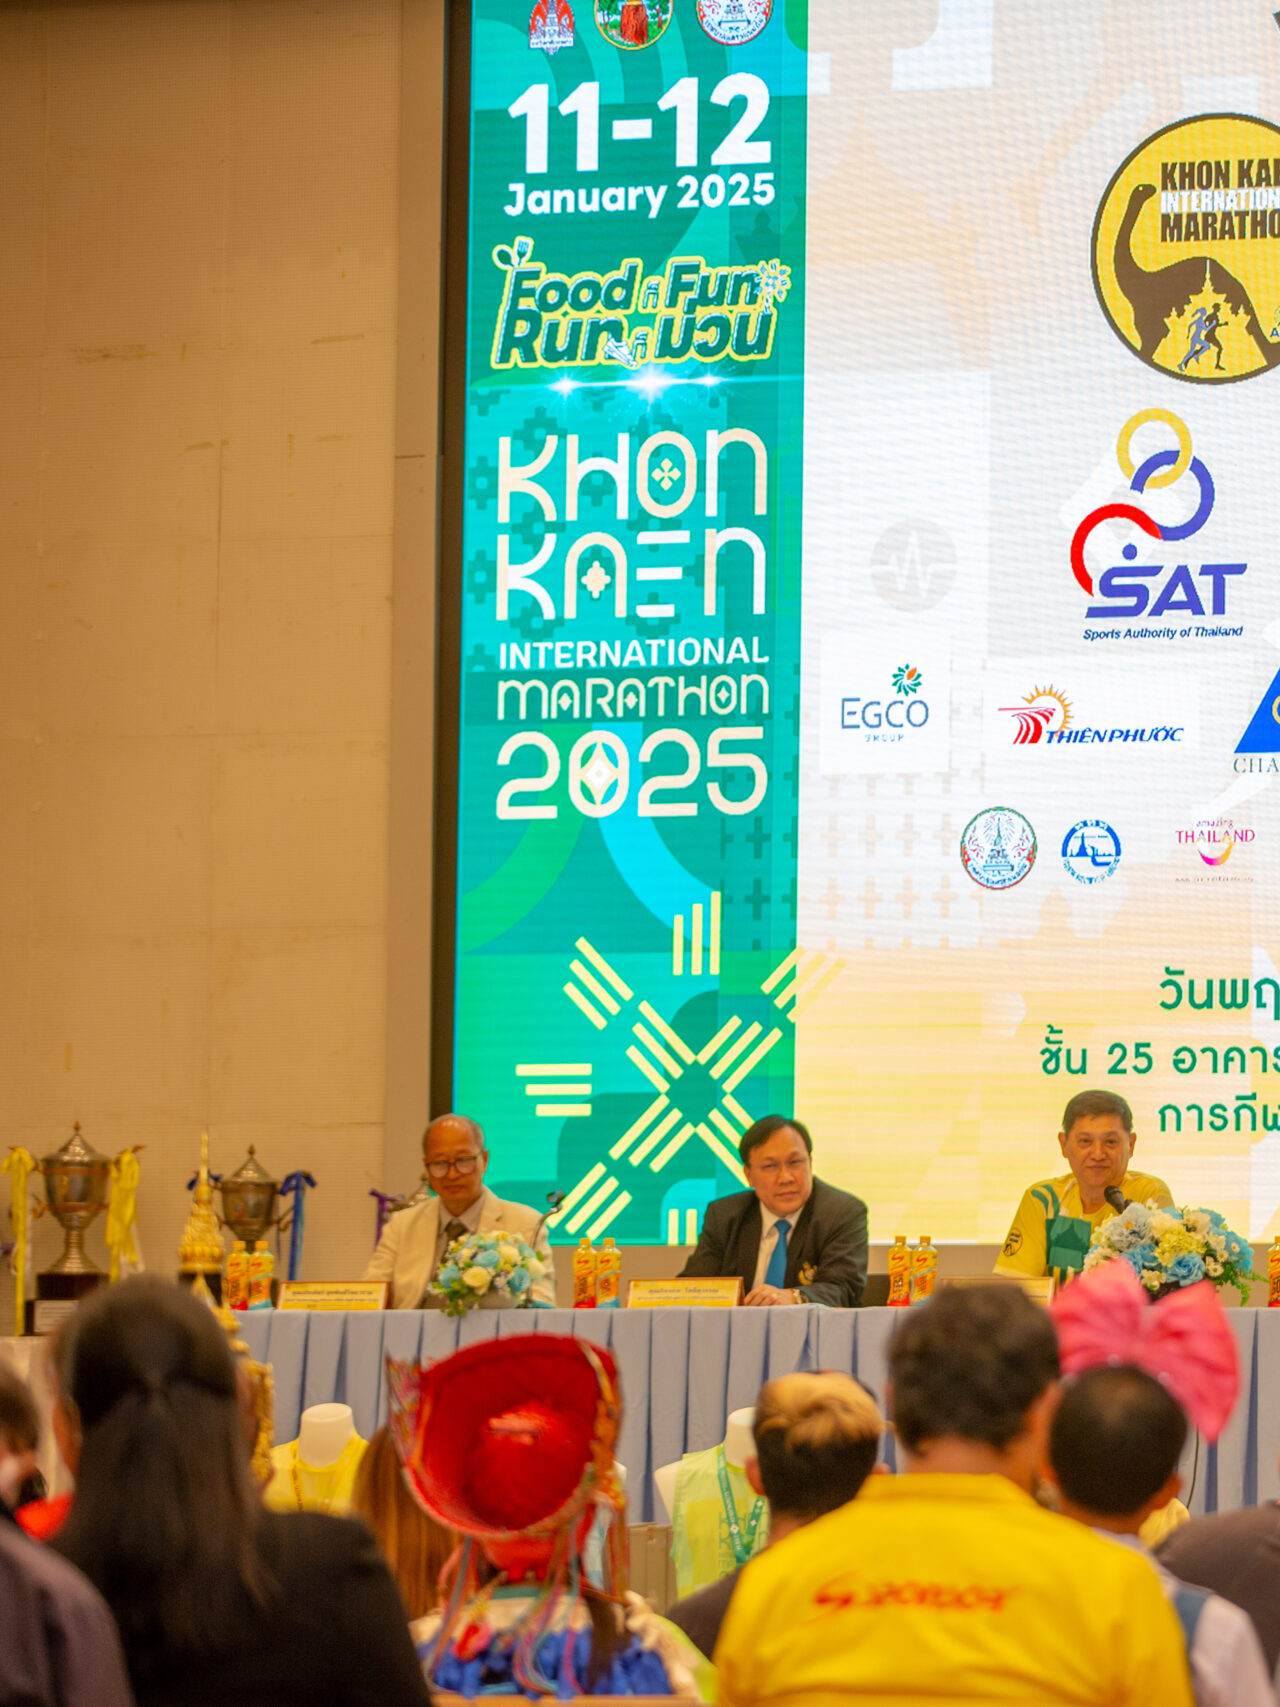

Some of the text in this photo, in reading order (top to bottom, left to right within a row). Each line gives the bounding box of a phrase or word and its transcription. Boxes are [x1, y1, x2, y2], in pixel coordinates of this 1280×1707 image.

[507, 72, 772, 174] 11-12
[503, 172, 776, 219] January 2025
[1161, 160, 1231, 190] KHON
[504, 262, 639, 314] Food
[665, 261, 760, 308] Fun
[496, 308, 628, 364] Run
[497, 427, 767, 523] KHON
[496, 527, 766, 620] KAEN
[1085, 562, 1248, 618] SAT
[500, 636, 769, 670] INTERNATIONAL
[1083, 625, 1244, 641] Sports Authority of Thailand
[498, 673, 769, 720] MARATHON
[842, 697, 929, 729] EGCO
[496, 726, 767, 820] 2025
[1175, 829, 1256, 844] THAILAND
[1039, 1024, 1088, 1075] ชั้น
[1106, 1042, 1154, 1075] 25
